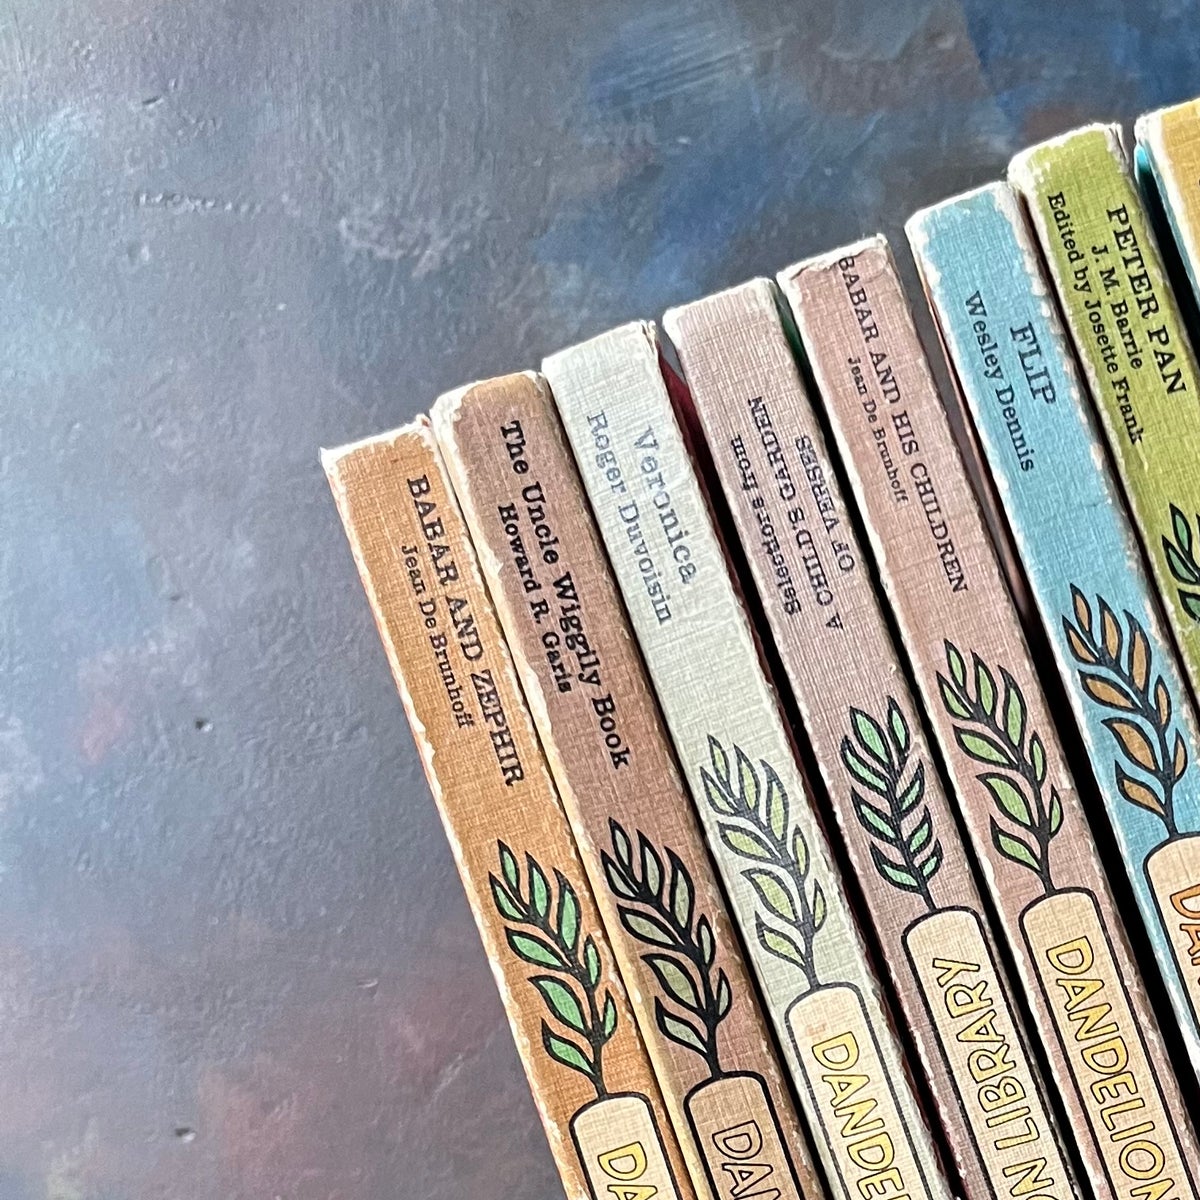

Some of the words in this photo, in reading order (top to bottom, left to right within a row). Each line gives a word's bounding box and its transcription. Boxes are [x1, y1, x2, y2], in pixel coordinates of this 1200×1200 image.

[1090, 243, 1109, 263] J.
[1098, 266, 1120, 296] M.
[1106, 203, 1160, 320] PETER
[1146, 325, 1187, 395] PAN
[1009, 321, 1056, 406] FLIP
[1047, 192, 1085, 264] Edited
[1072, 266, 1093, 294] by
[1083, 298, 1120, 374] Josette
[1110, 376, 1145, 446] Frank
[1109, 299, 1144, 370] Barrie
[835, 255, 879, 343] BABAR
[868, 350, 901, 405] AND
[891, 410, 920, 456] HIS
[910, 461, 969, 594] CHILDREN
[847, 356, 869, 396] Jean
[862, 398, 879, 423] De
[871, 426, 909, 503] Brunhoff
[963, 290, 1005, 381] Wesley
[995, 384, 1036, 472] Dennis
[728, 434, 759, 492] from
[747, 396, 796, 501] GARDEN
[794, 435, 841, 533] VERSES
[584, 409, 628, 495] Roger
[617, 500, 674, 626] Duvoisin
[632, 426, 699, 585] Veronica
[786, 506, 834, 607] CHILD'S
[830, 538, 856, 574] OF
[400, 544, 427, 596] Jean
[418, 597, 439, 630] De
[497, 502, 542, 594] Howard
[529, 598, 551, 625] R.
[540, 630, 573, 694] Garis
[499, 420, 531, 475] The
[520, 481, 561, 565] Uncle
[549, 571, 603, 688] Wiggily
[590, 693, 632, 770] Book
[824, 612, 843, 631] A
[405, 473, 460, 587] BABAR
[444, 593, 485, 663] AND
[469, 668, 526, 788] ZEPHIR
[428, 631, 475, 730] Brunhoff
[931, 953, 1041, 1152] LIBRARY
